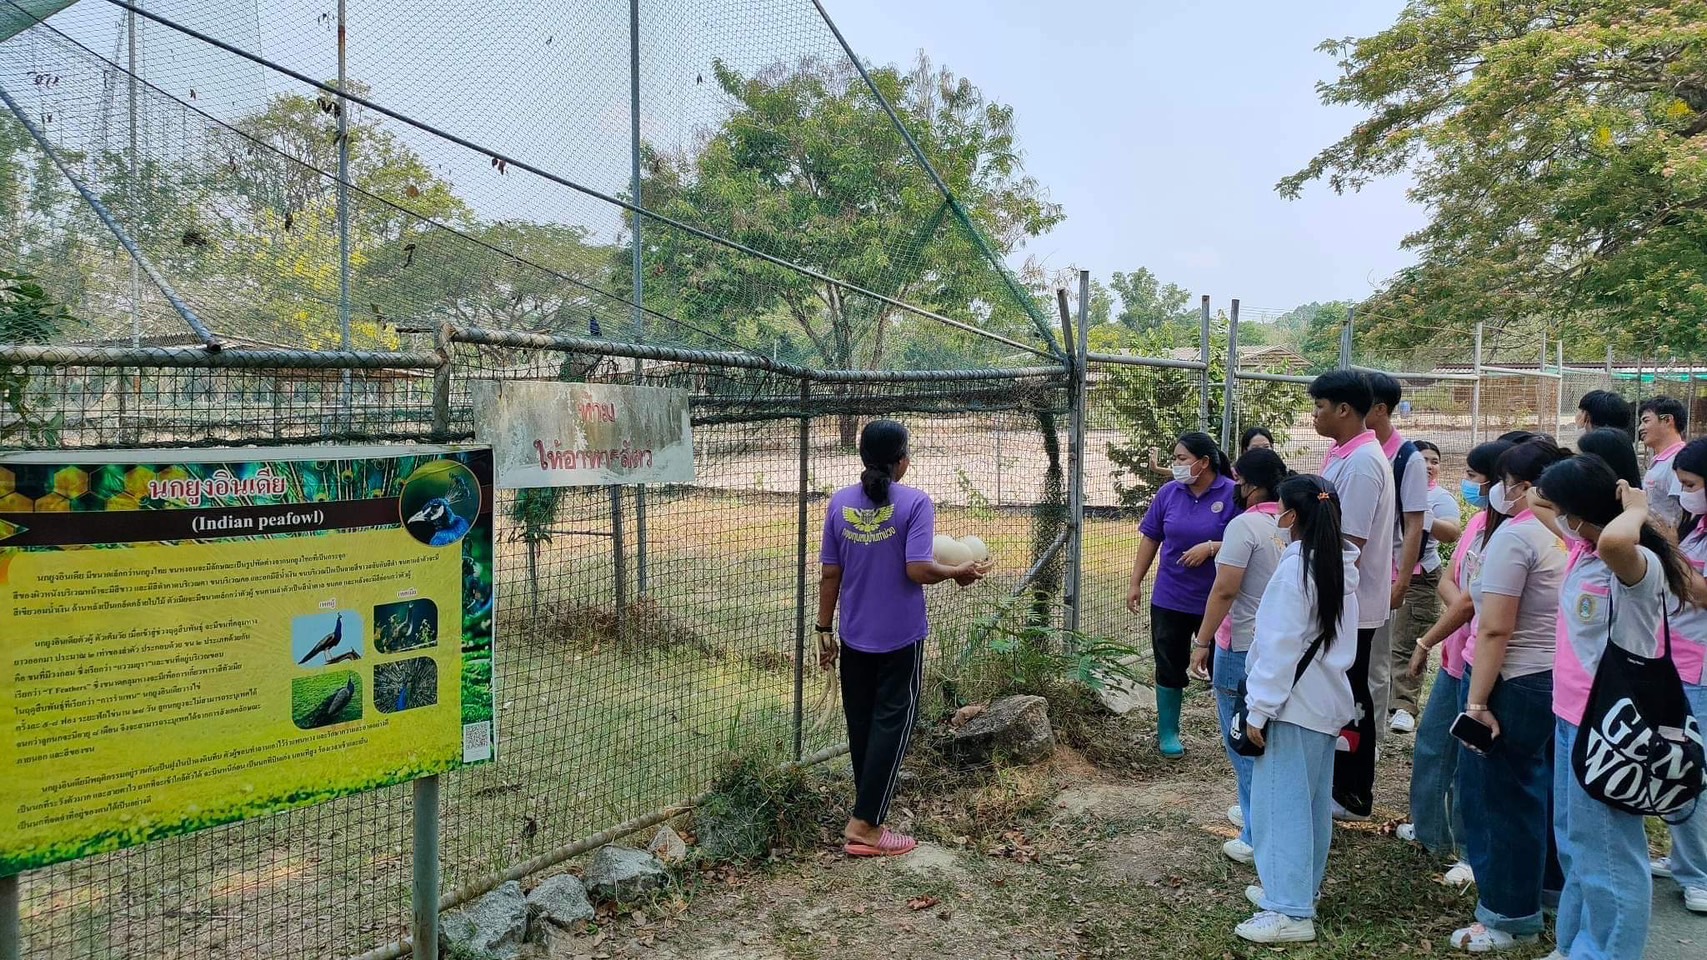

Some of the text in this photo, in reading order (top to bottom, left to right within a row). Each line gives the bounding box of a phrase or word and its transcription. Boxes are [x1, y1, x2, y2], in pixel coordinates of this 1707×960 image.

[578, 390, 616, 423] ห้าม
[533, 438, 653, 471] ให้อาหารสัตว์
[149, 469, 286, 506] นกยูงอินเดีย
[192, 510, 324, 533] (Indian peafowl)
